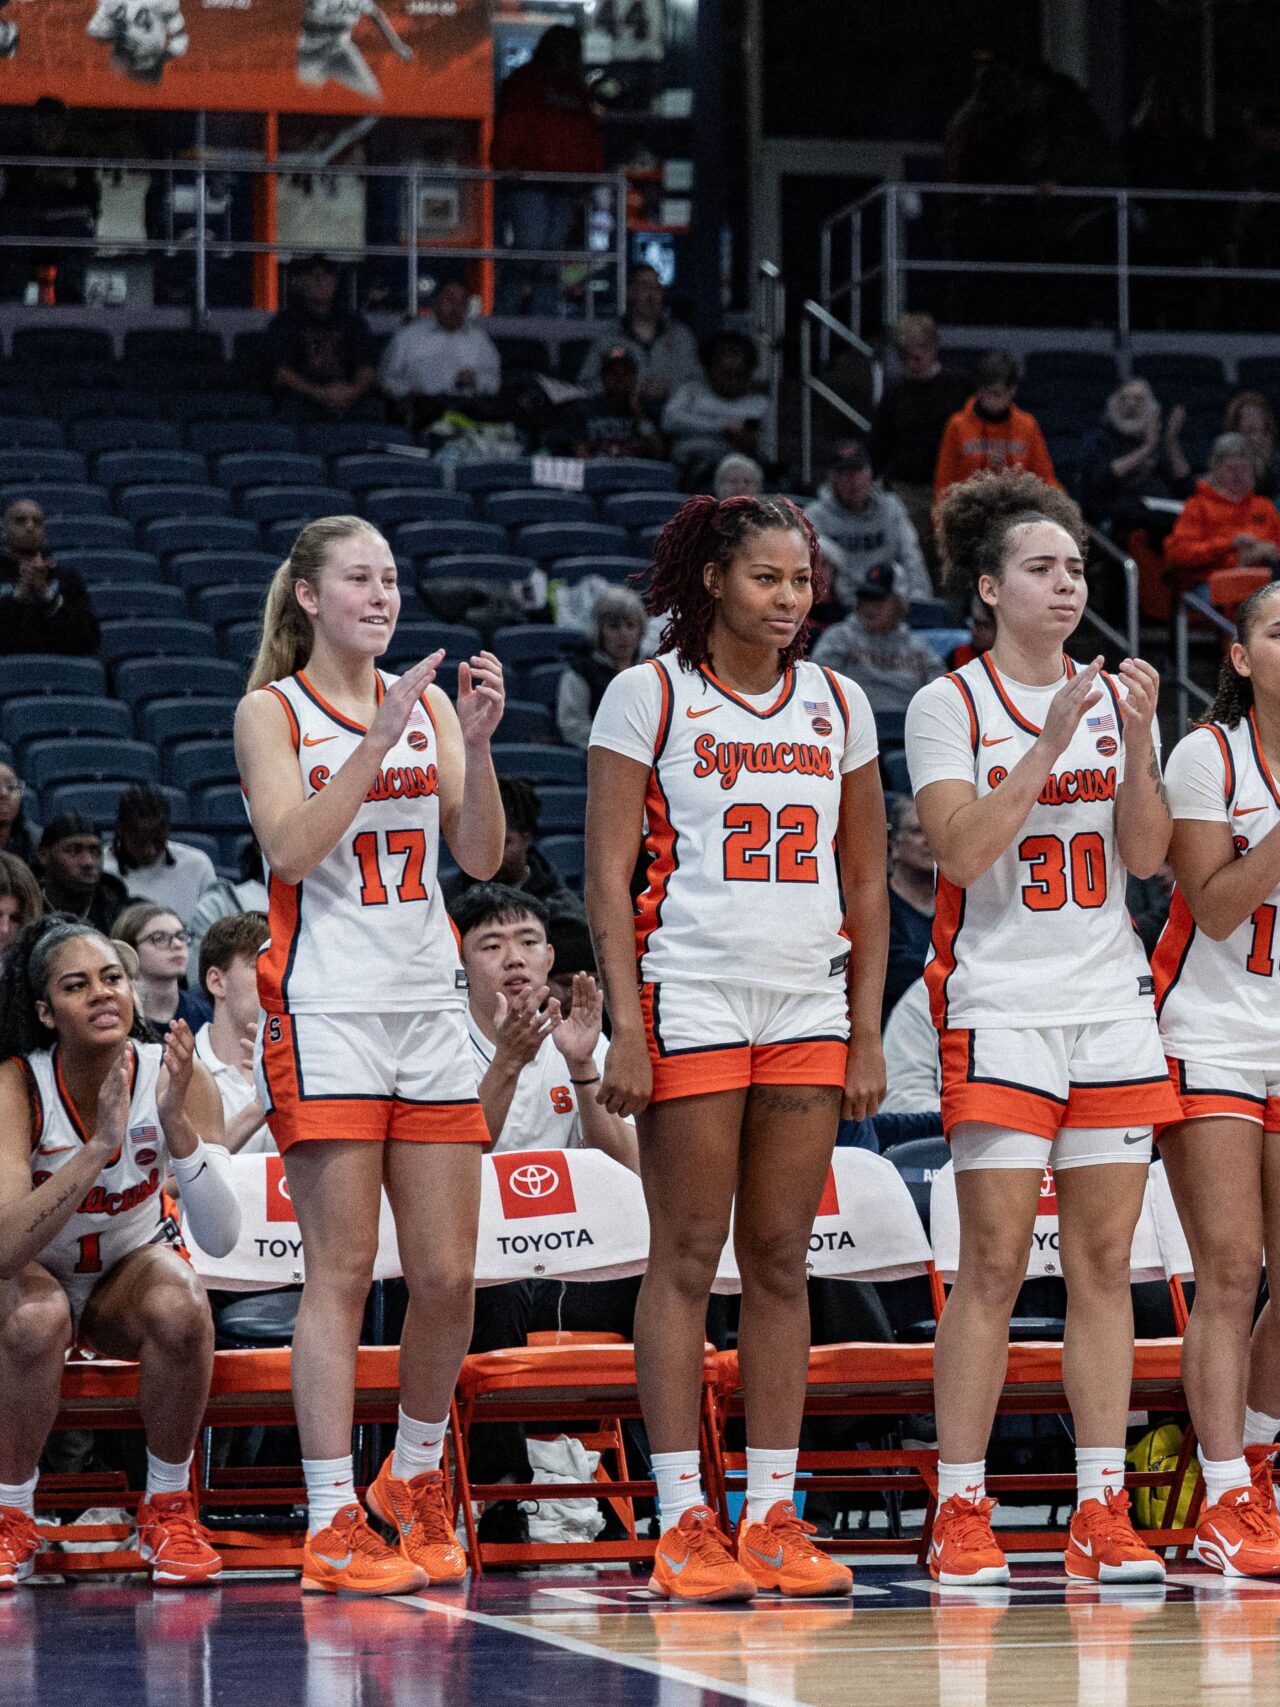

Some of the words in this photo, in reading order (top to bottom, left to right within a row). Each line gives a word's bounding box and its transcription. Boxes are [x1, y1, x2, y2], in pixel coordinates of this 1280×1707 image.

[694, 733, 834, 790] Syracuse
[308, 764, 439, 803] Sacuse
[722, 803, 819, 884] 22
[352, 828, 428, 906] 17
[1018, 831, 1107, 912] 30
[269, 1016, 282, 1043] S
[550, 1086, 573, 1114] S
[73, 1231, 103, 1274] 1
[254, 1239, 303, 1258] TOY
[497, 1229, 594, 1254] TOYOTA
[808, 1231, 856, 1252] OTA
